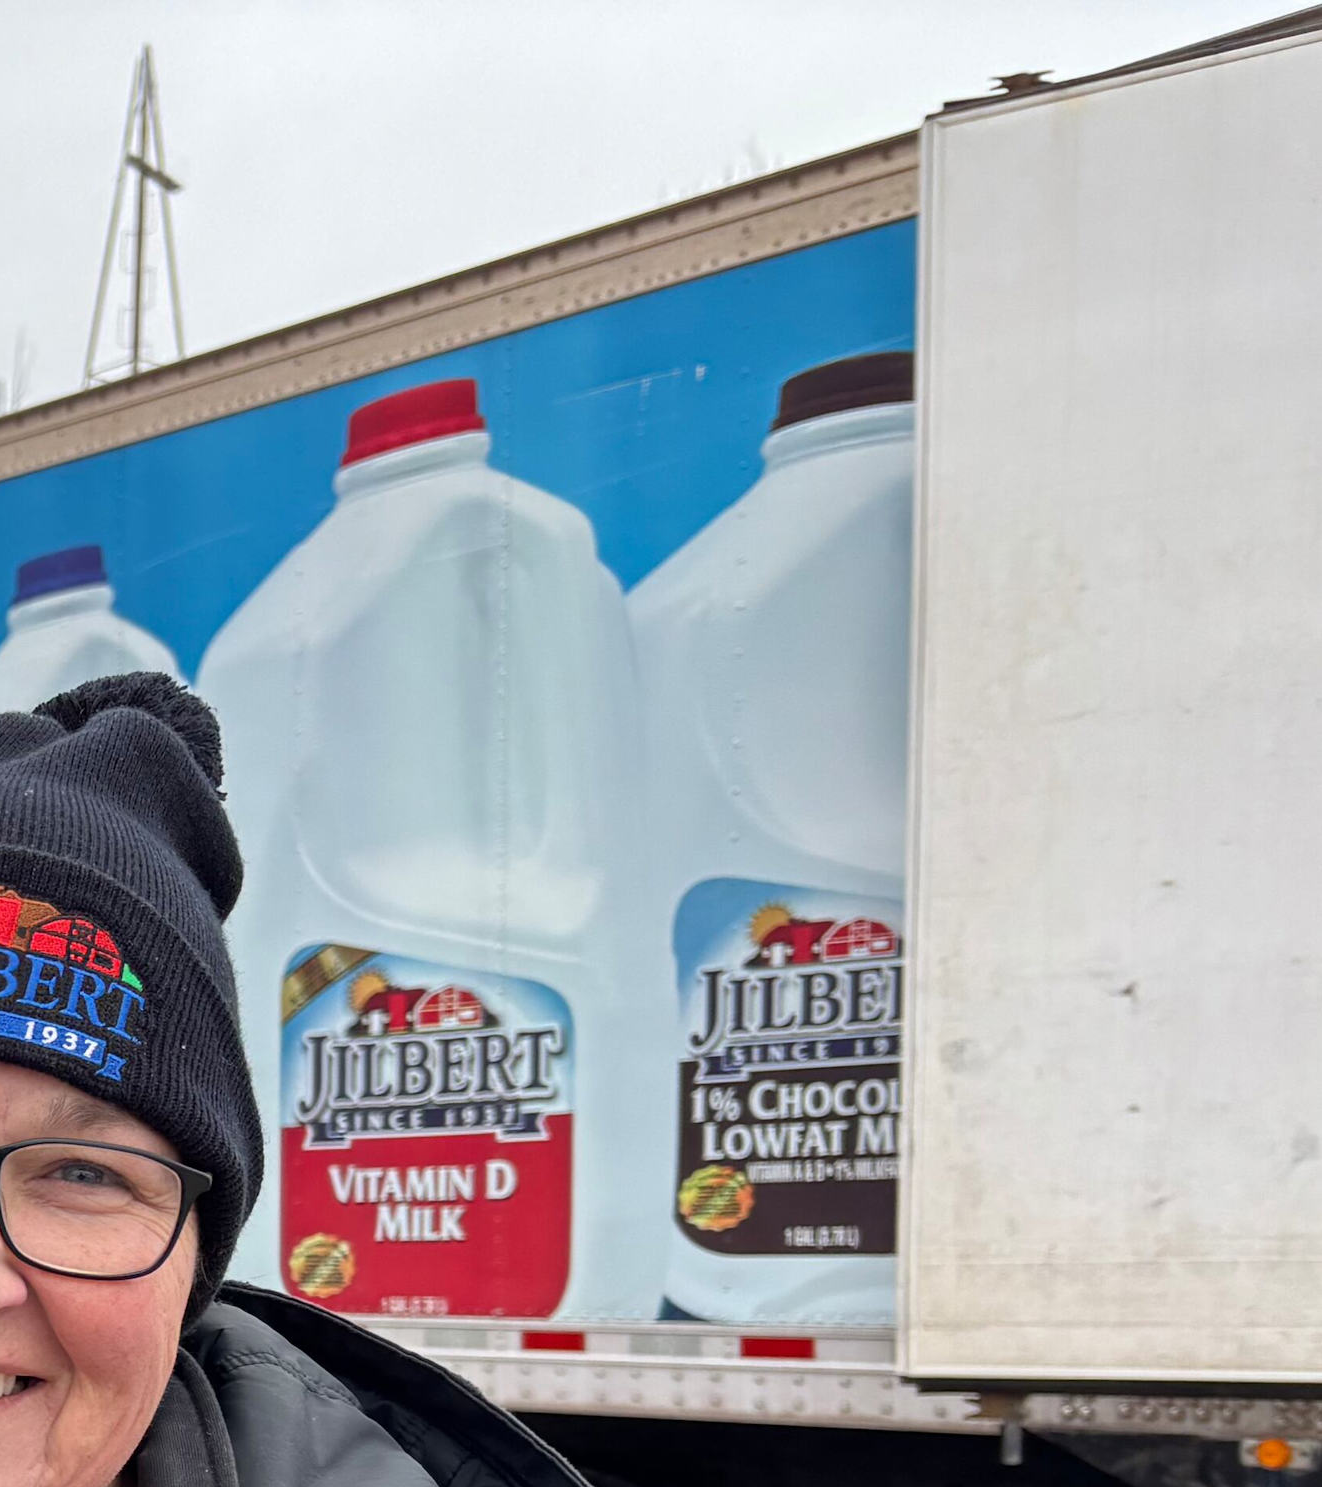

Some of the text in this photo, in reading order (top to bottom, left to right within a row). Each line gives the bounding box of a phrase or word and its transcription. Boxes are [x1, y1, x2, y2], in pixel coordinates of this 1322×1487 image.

[23, 1020, 100, 1059] 1937
[732, 1040, 832, 1067] SINCE
[296, 1028, 562, 1123] JILBERT
[332, 1103, 520, 1135] SINCE 1937
[690, 1085, 742, 1124] 1%
[701, 1120, 850, 1162] LOWFAT
[327, 1158, 518, 1204] VITAMIN D
[374, 1204, 468, 1242] MILK
